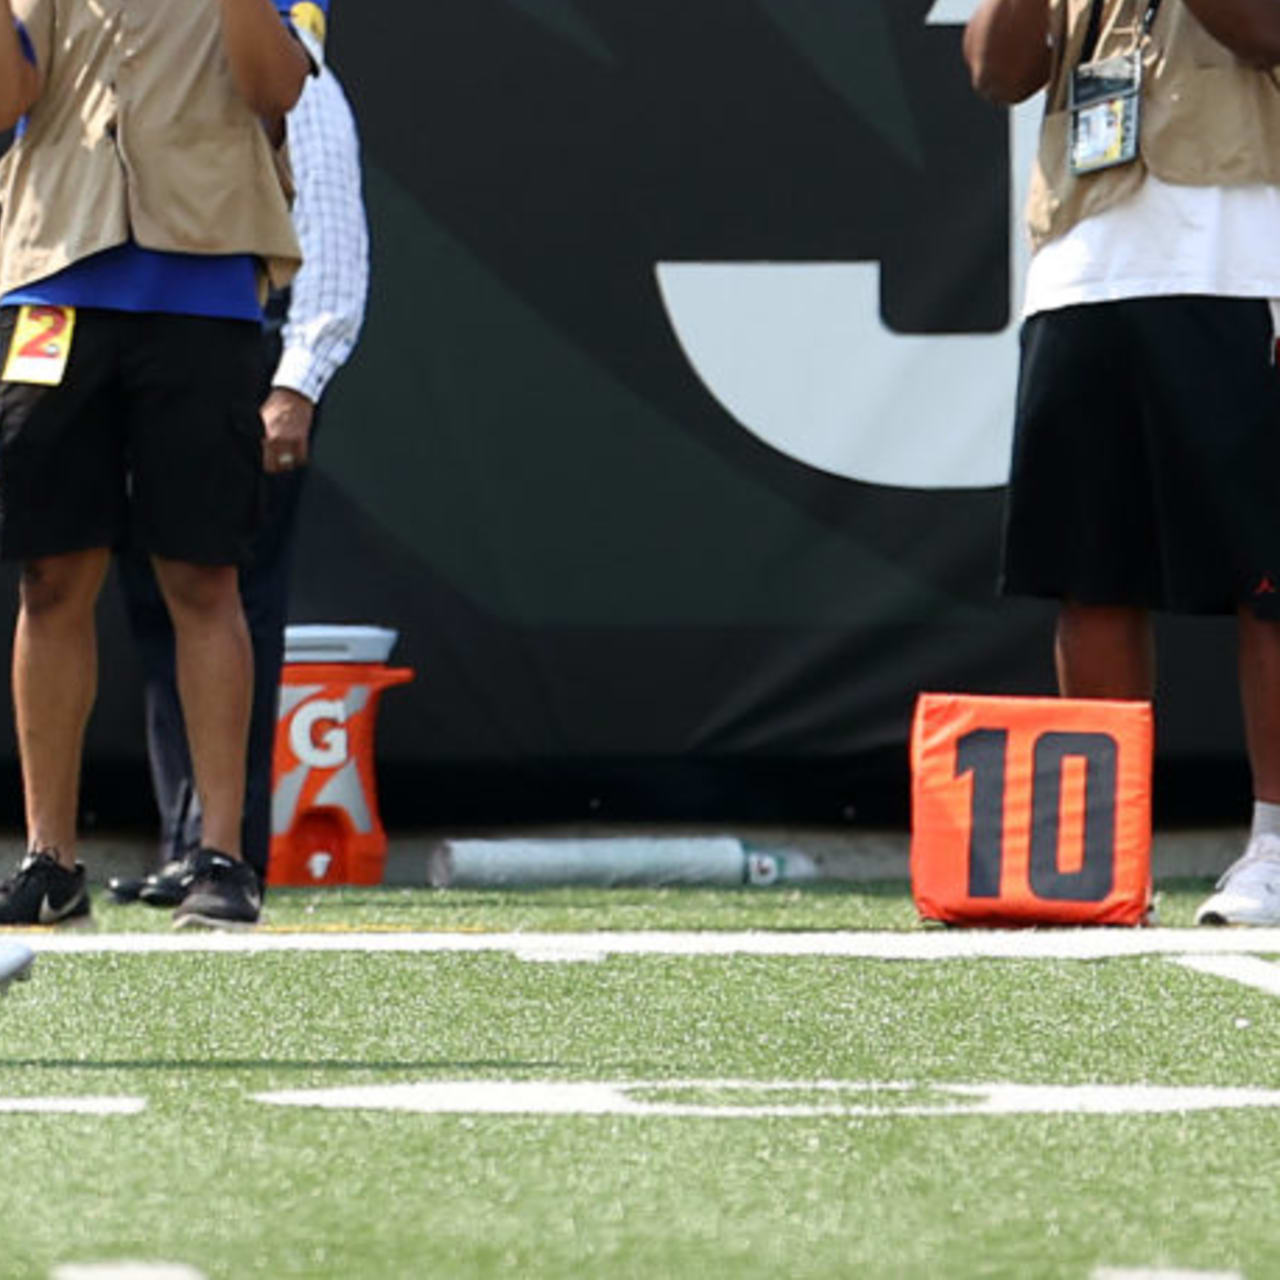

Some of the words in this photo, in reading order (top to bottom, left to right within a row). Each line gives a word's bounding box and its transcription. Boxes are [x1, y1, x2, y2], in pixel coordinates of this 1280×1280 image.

[17, 306, 68, 359] 2
[288, 698, 349, 769] G
[951, 726, 1120, 904] 10
